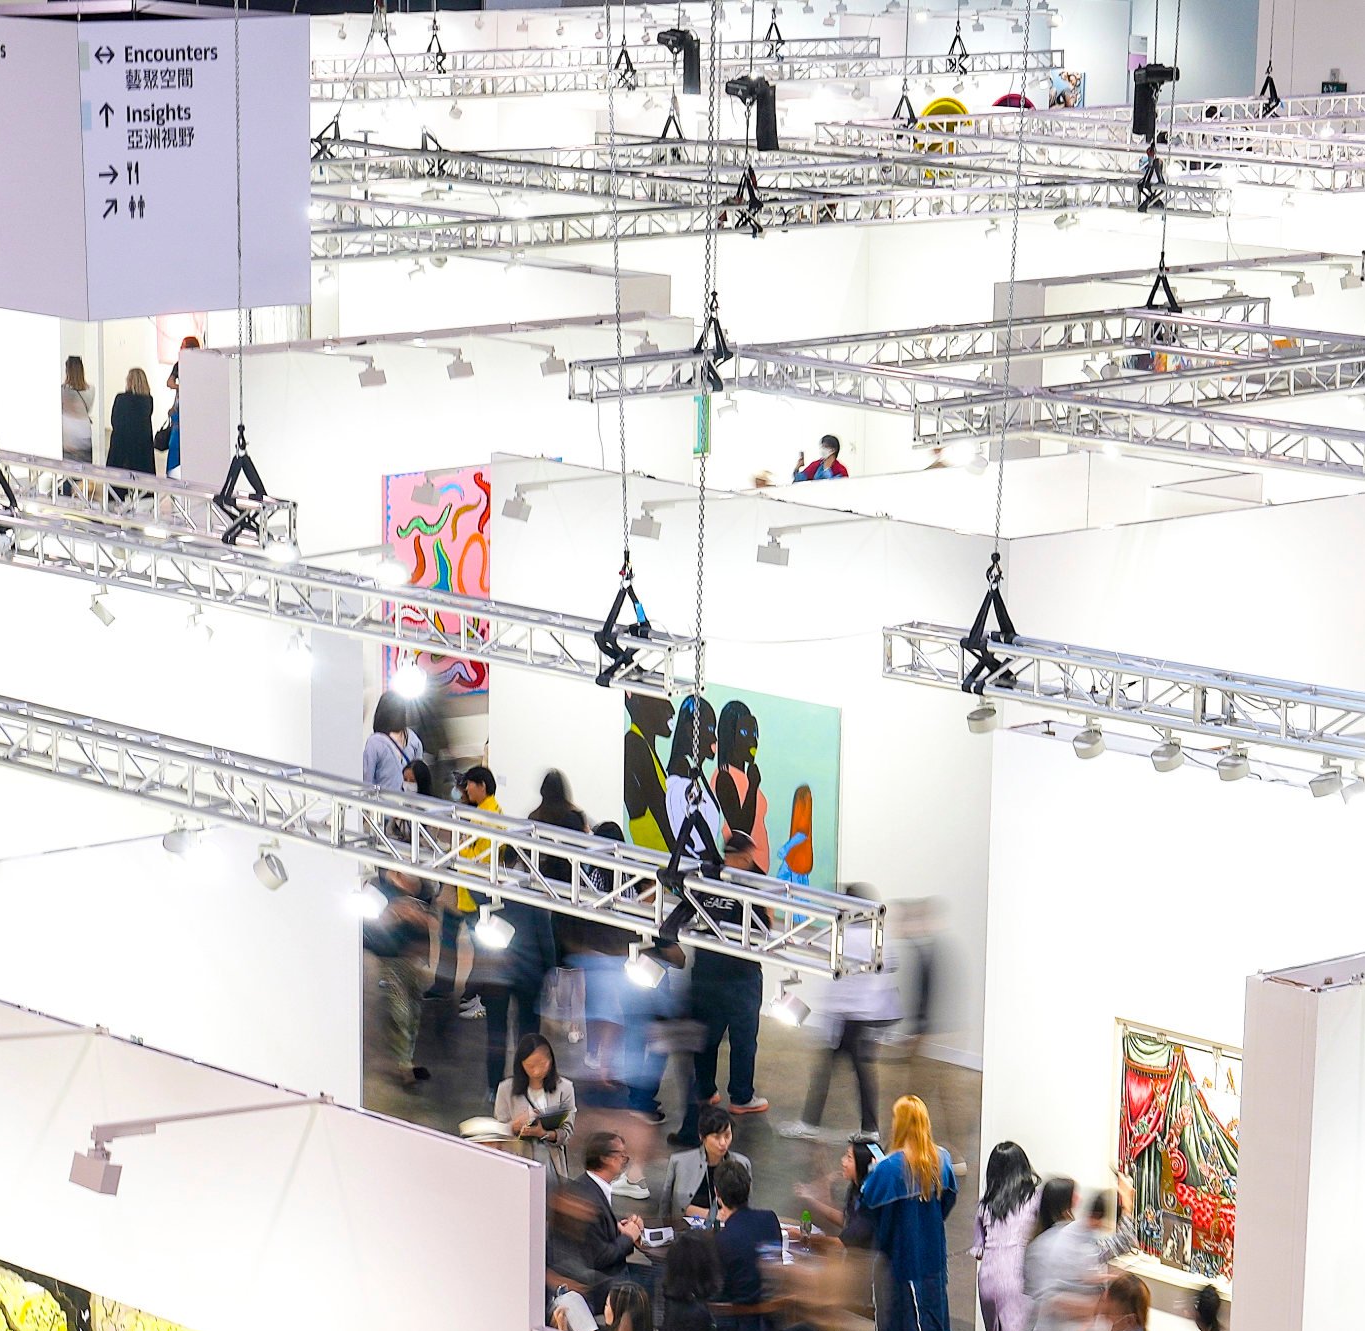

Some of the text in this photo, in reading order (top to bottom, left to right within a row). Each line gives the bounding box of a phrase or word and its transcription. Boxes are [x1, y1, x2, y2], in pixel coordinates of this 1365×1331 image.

[124, 44, 218, 63] Encounters
[125, 67, 193, 91] 藝聚空間
[126, 102, 192, 126] Insights
[127, 126, 195, 150] 亞洲視野
